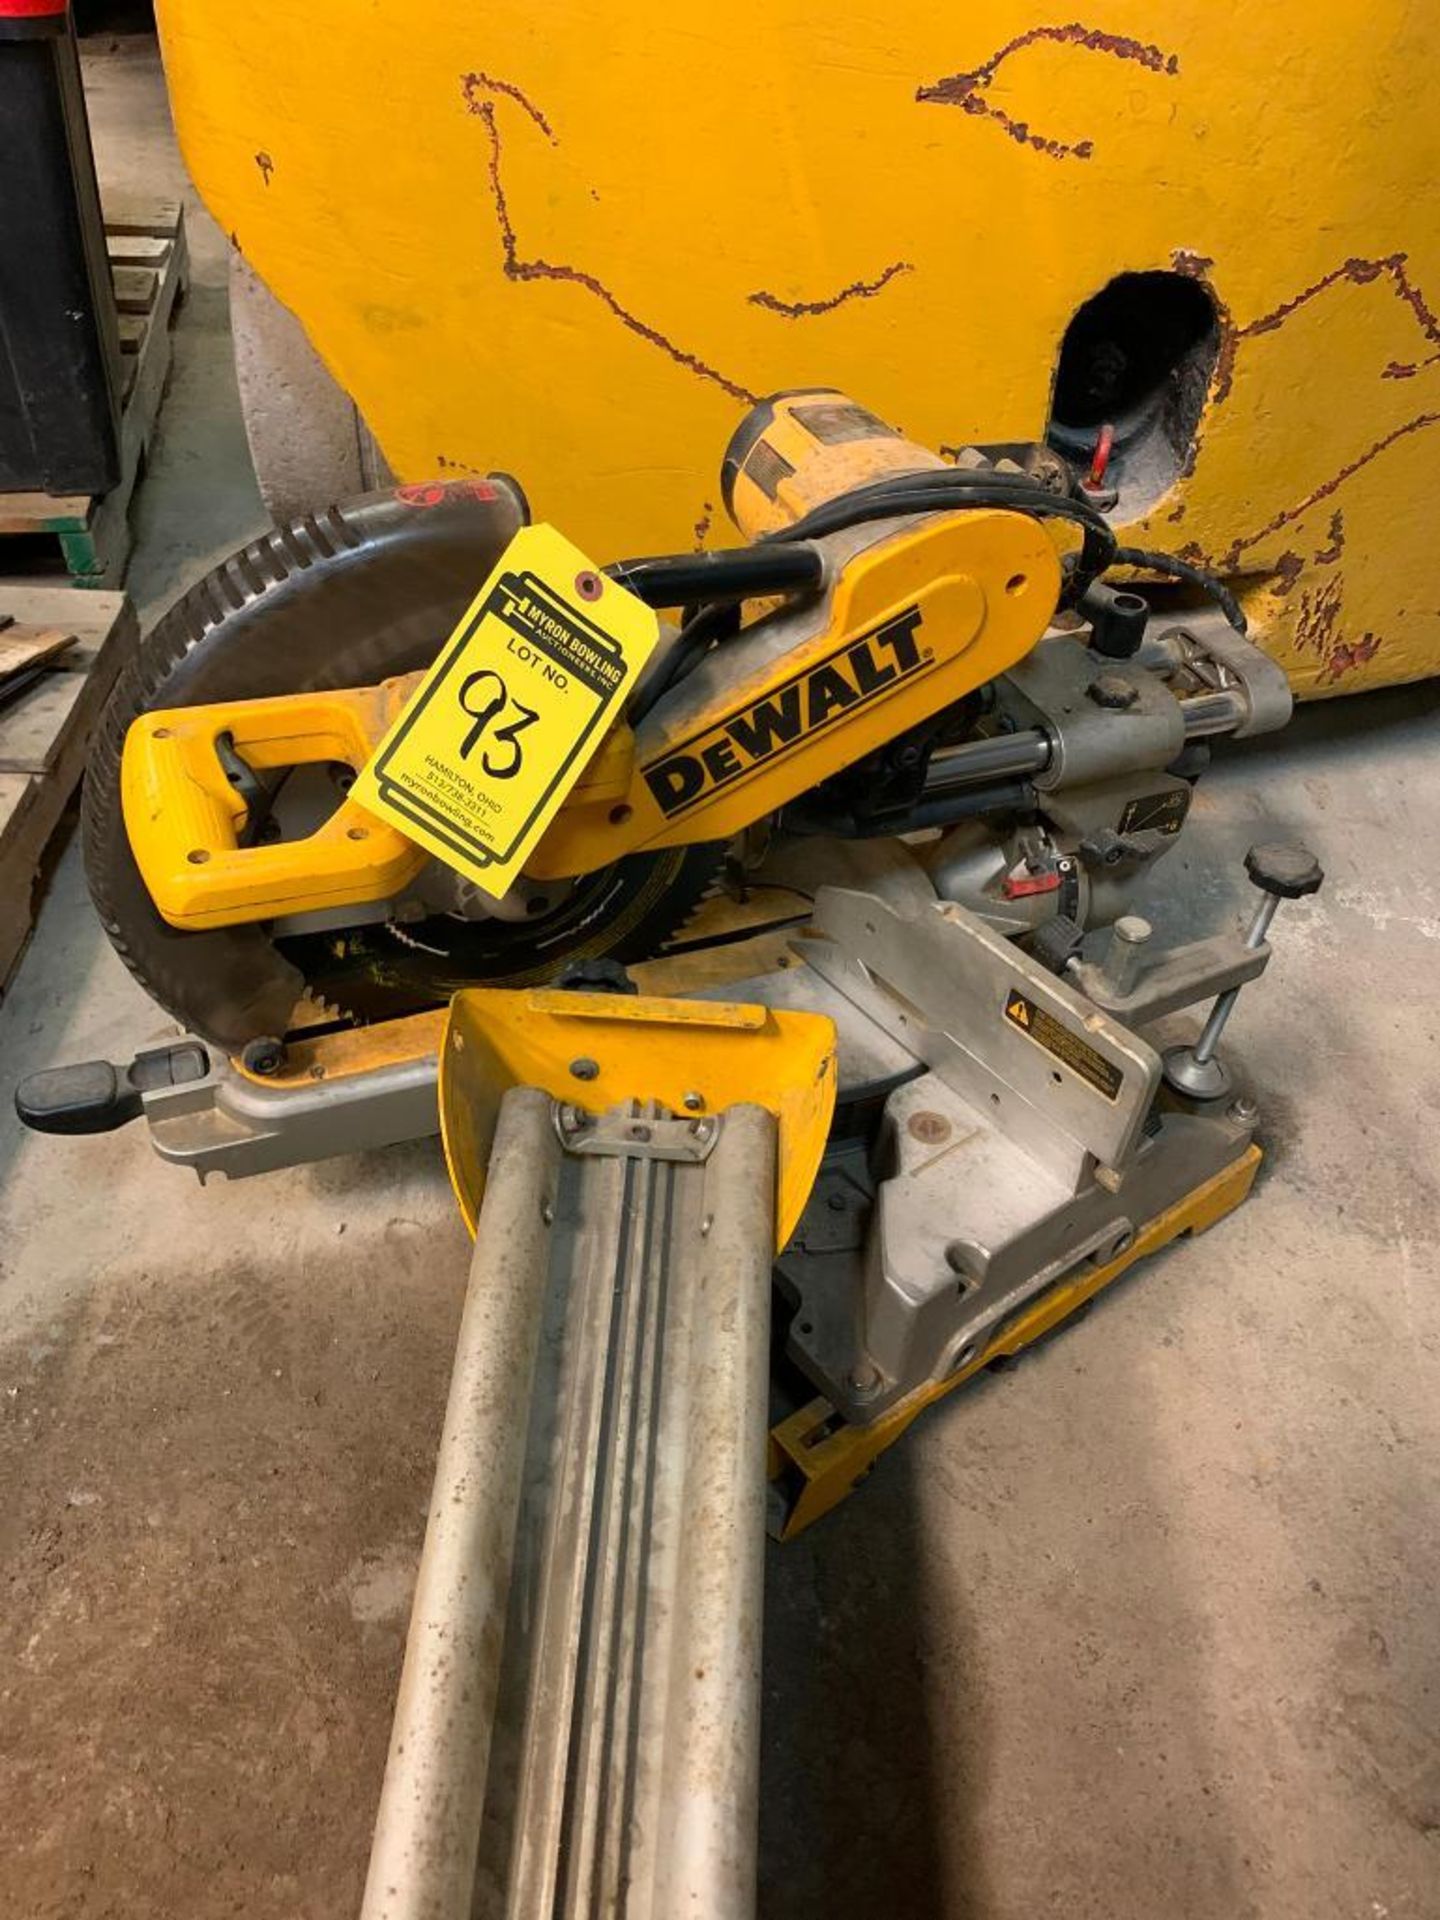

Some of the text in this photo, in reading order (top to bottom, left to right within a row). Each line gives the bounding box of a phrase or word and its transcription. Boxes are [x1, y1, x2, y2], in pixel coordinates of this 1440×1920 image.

[506, 638, 568, 694] LOT NO.
[527, 605, 622, 683] MYRON BOWLING
[458, 669, 540, 779] 93
[400, 773, 495, 843] myronbowling.com
[476, 792, 503, 814] OHIO
